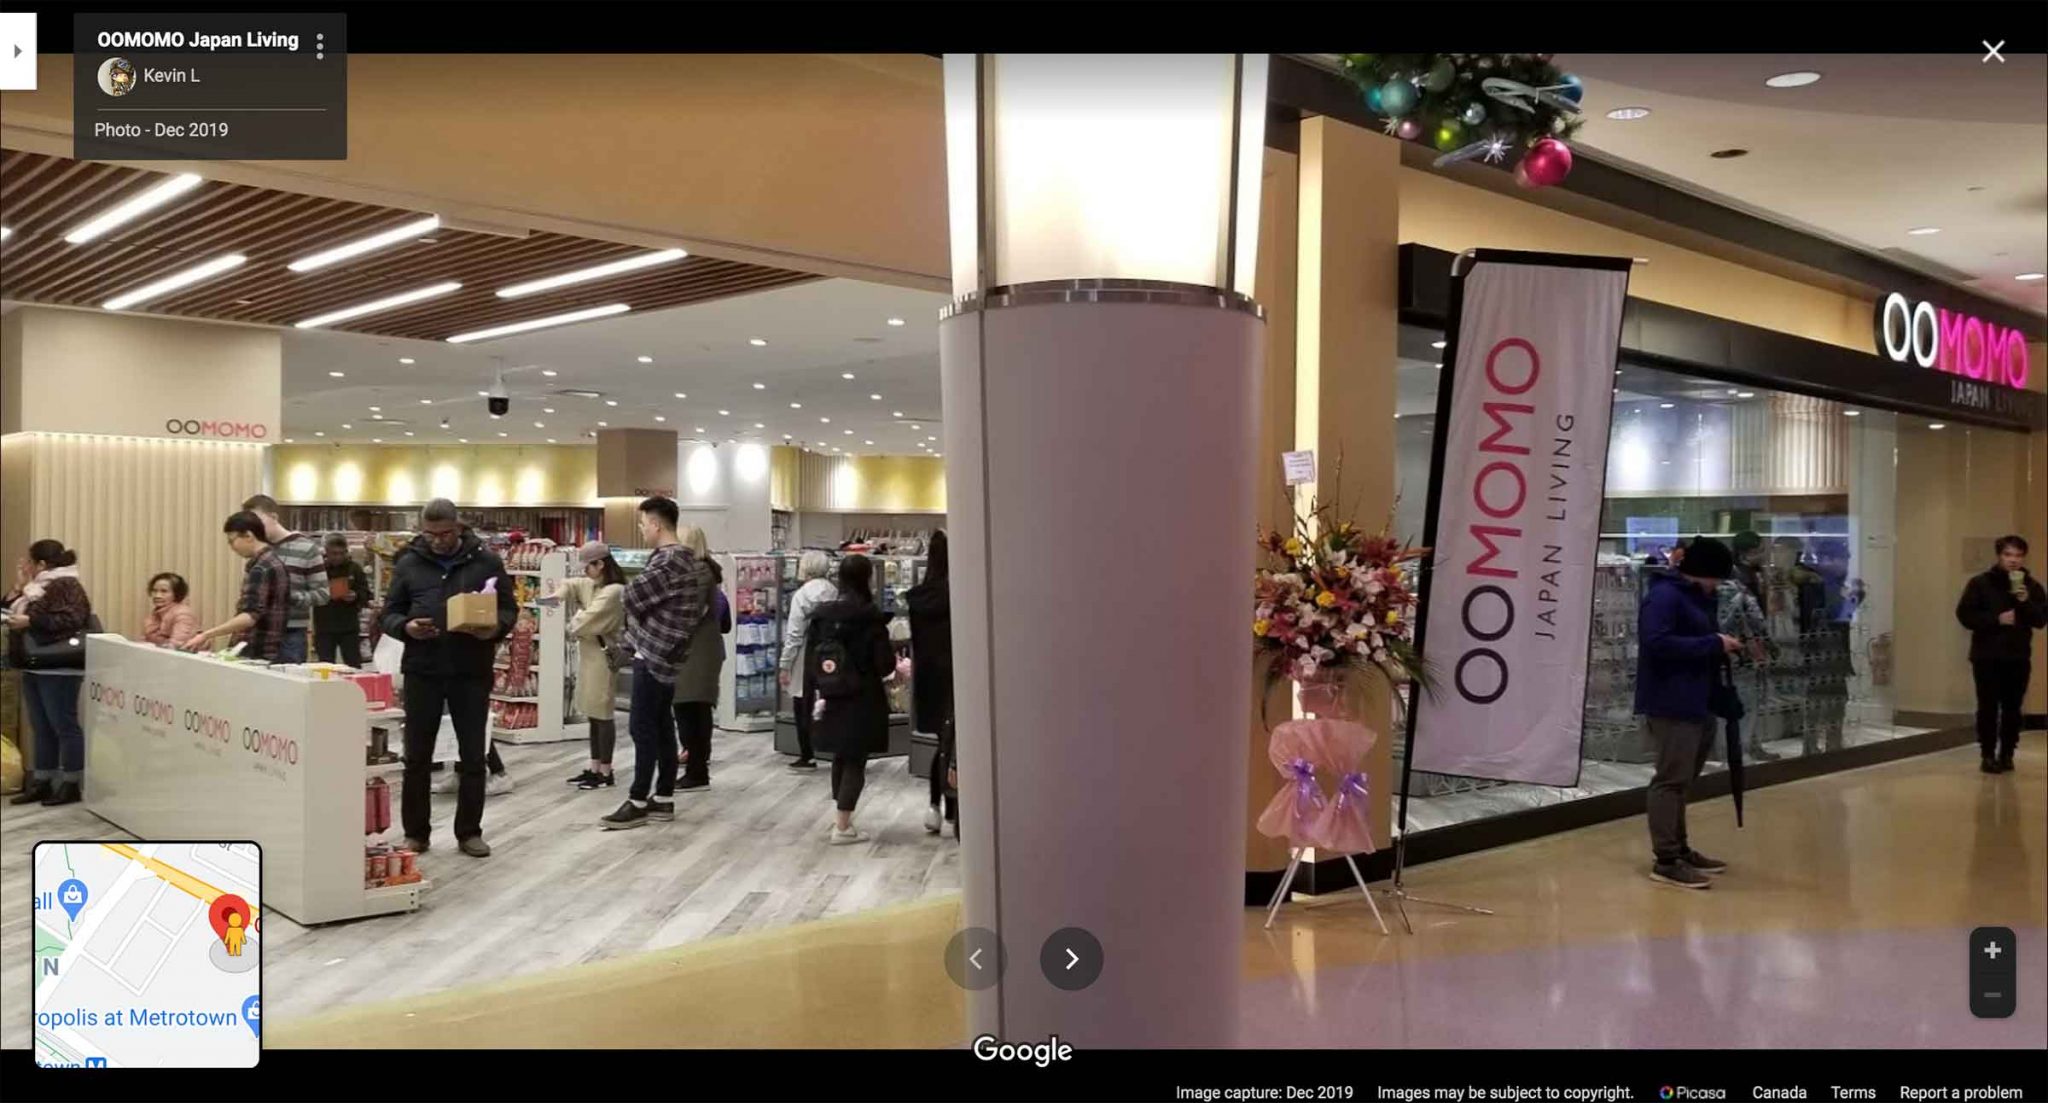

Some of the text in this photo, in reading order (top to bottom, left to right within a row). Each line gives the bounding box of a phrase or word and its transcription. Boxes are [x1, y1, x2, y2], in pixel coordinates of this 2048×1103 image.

[1883, 291, 2028, 389] OOMOMO
[1951, 379, 1990, 411] JAPAN
[166, 419, 267, 438] OOMOMO
[1454, 337, 1540, 704] OOMOMO
[1535, 413, 1575, 641] JAPAN LIVING
[134, 694, 174, 725] OOMOMO
[184, 709, 231, 743] OOMOMO
[242, 726, 298, 765] OOMOMO
